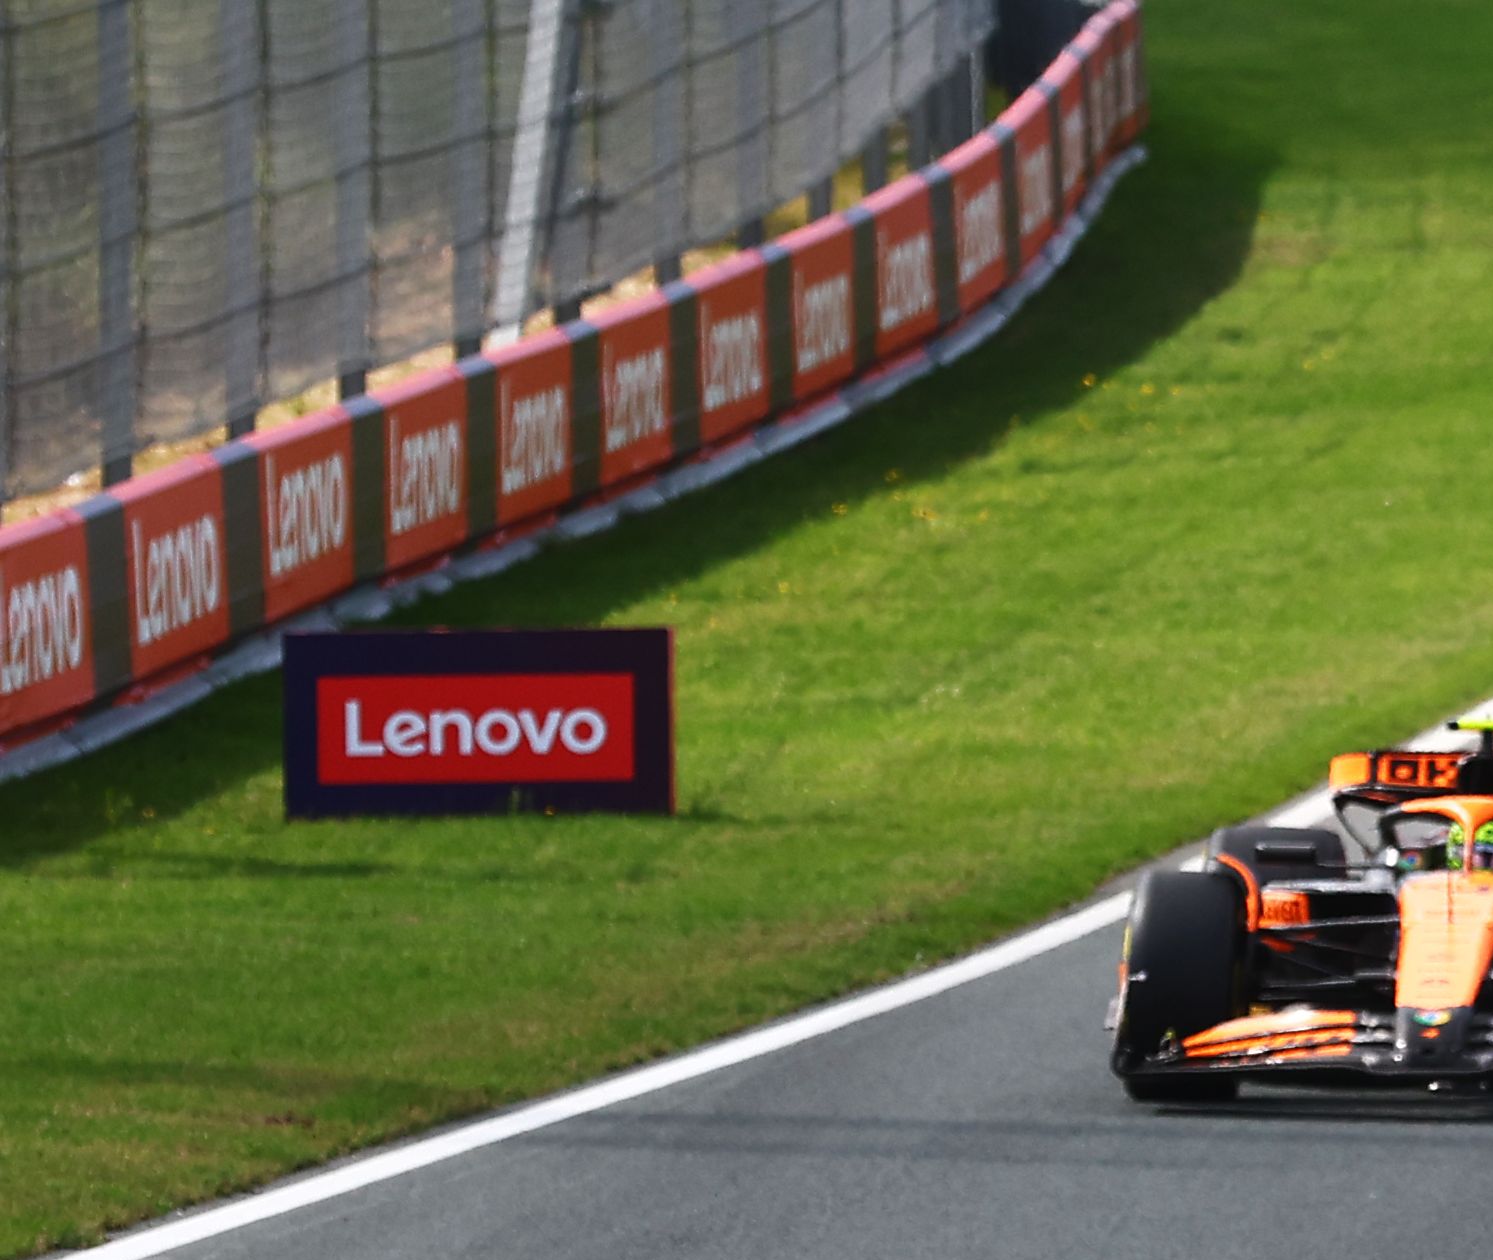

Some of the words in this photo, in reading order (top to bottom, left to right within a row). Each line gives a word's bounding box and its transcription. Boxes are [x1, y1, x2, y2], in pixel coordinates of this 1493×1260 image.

[390, 415, 460, 534] Lenovo
[501, 382, 567, 495] Lenovo
[266, 453, 347, 577] Lenovo
[132, 514, 220, 645] Lenovo
[344, 699, 606, 757] Lenovo
